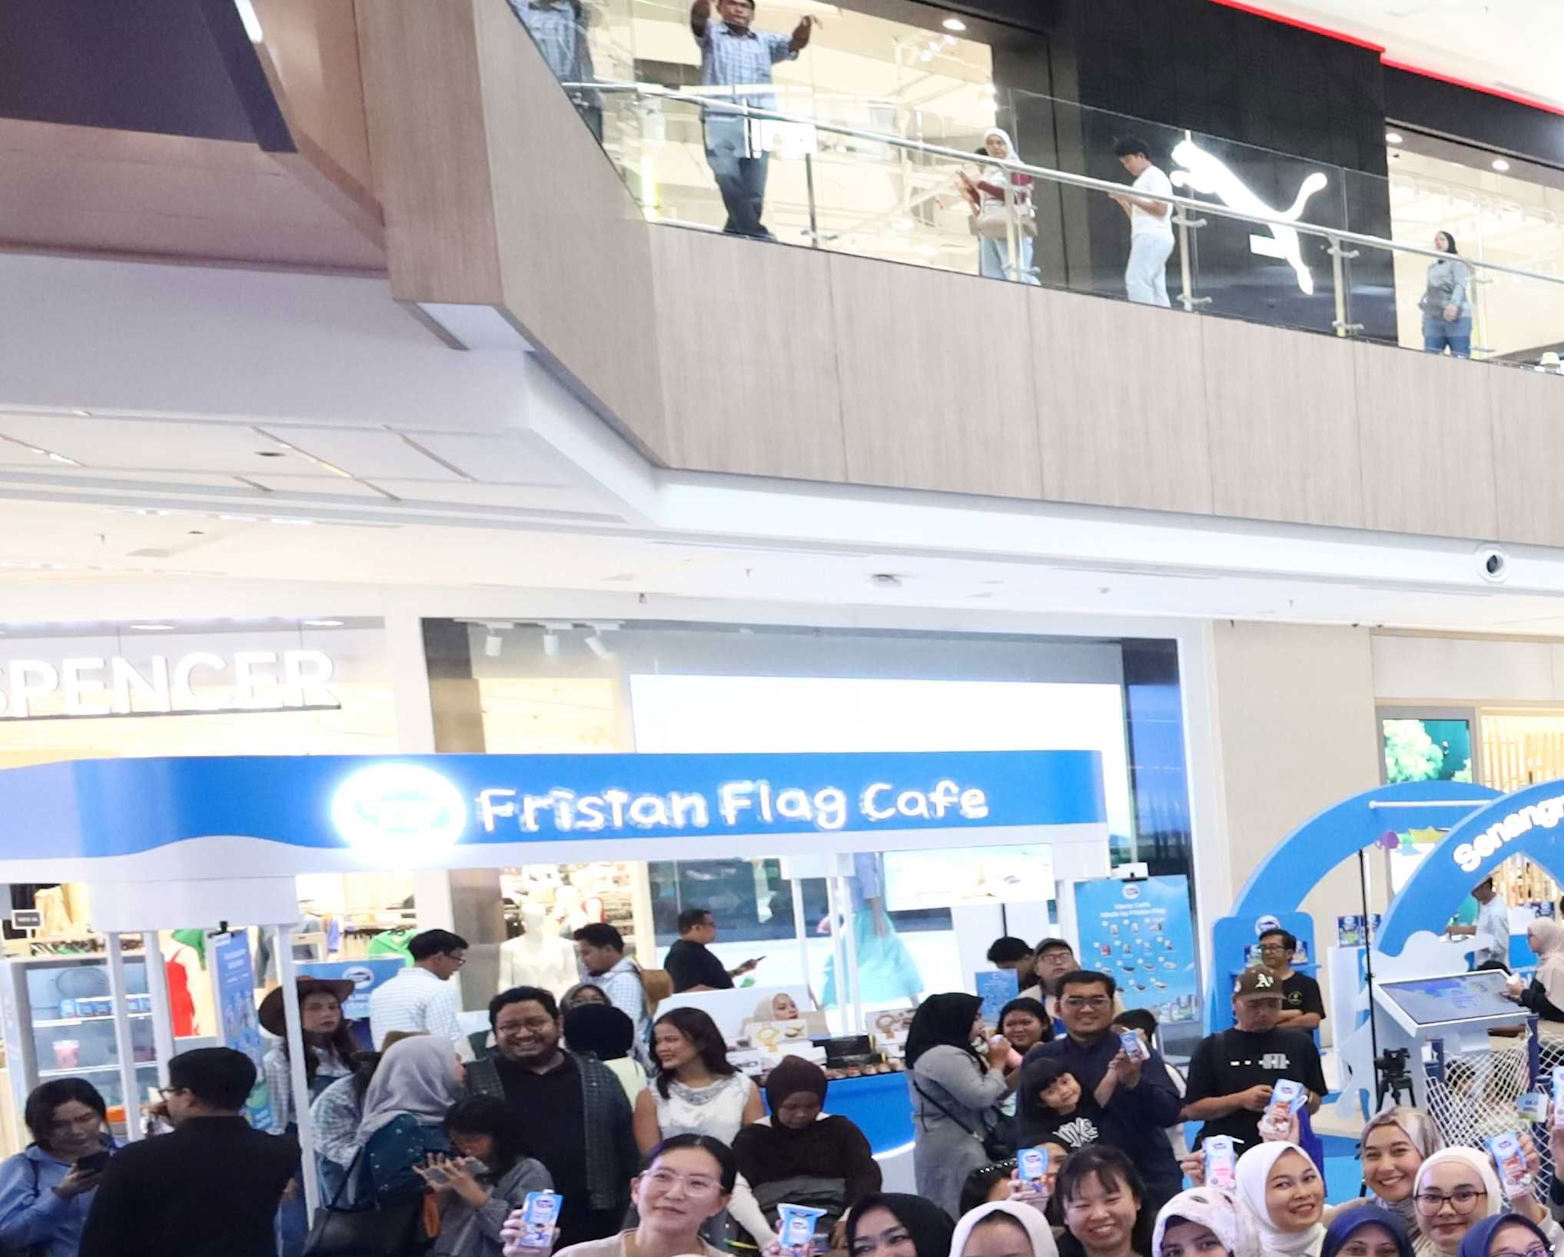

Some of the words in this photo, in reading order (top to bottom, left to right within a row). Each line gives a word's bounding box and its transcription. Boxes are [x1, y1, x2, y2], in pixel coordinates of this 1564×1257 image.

[0, 650, 341, 717] PENCER
[717, 779, 847, 830] Flag
[861, 779, 989, 820] Cafe
